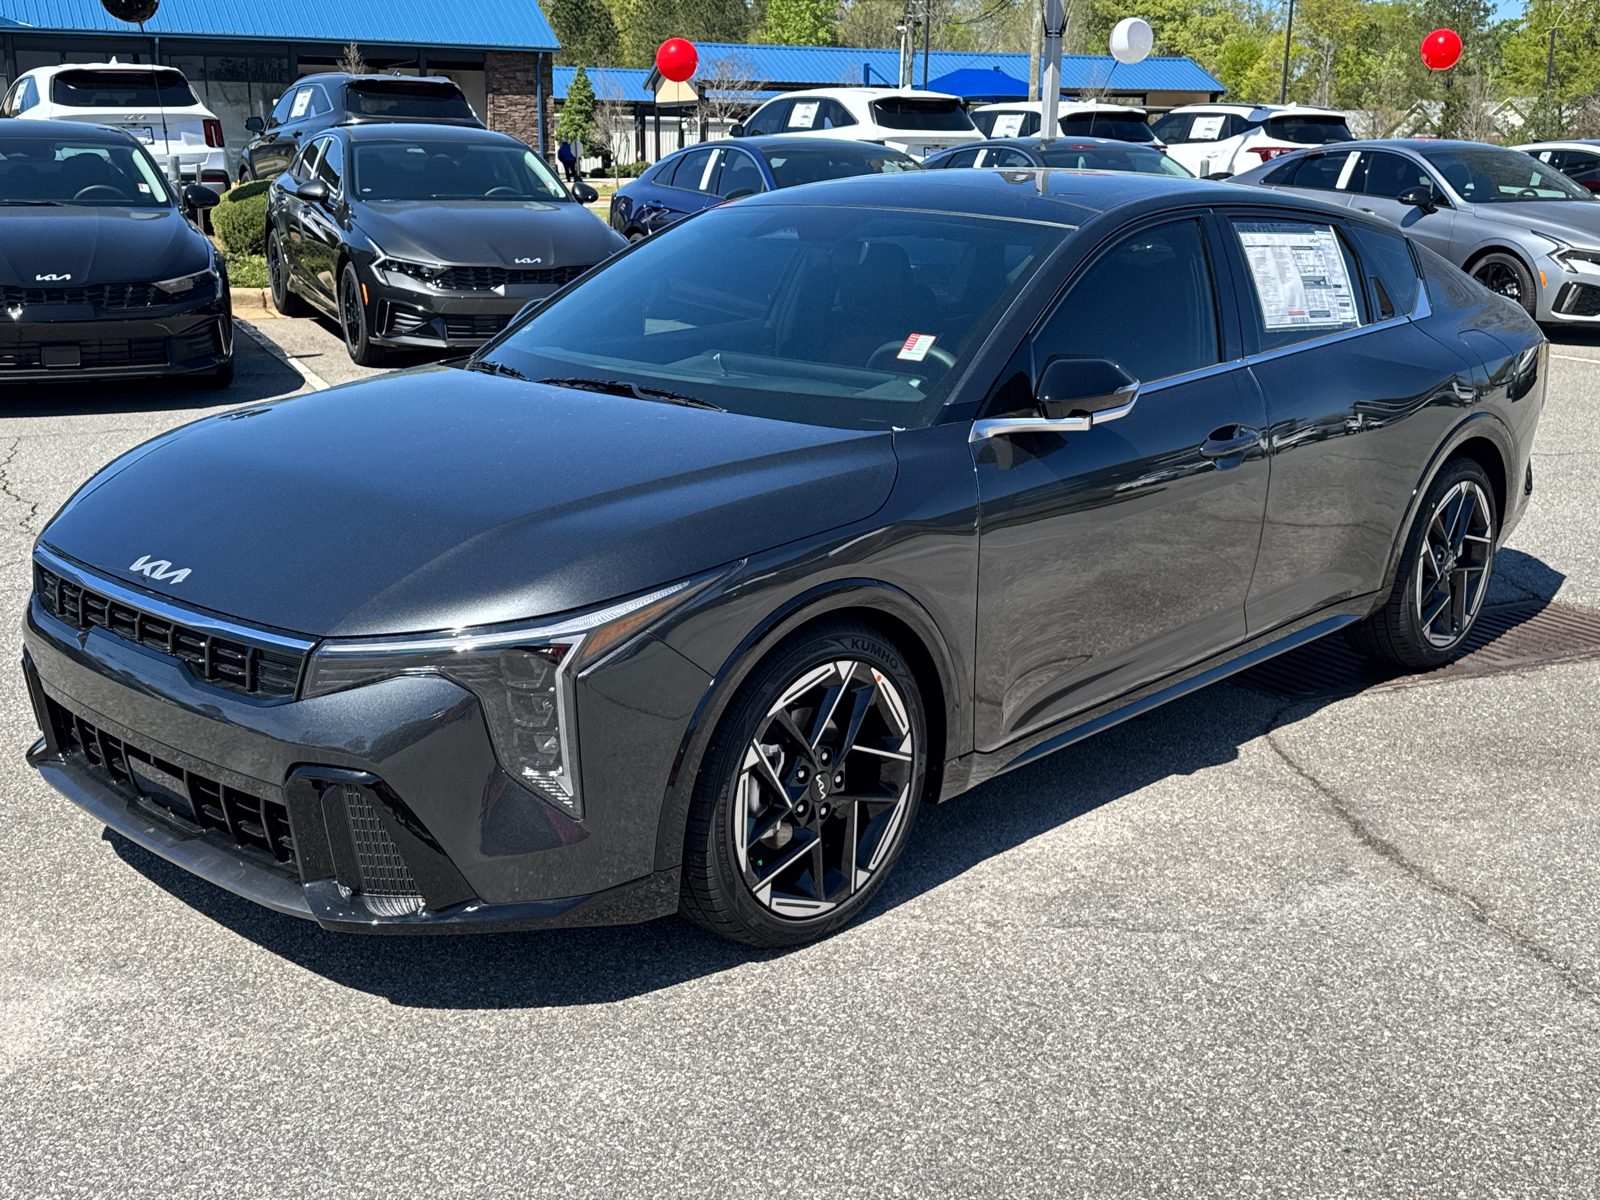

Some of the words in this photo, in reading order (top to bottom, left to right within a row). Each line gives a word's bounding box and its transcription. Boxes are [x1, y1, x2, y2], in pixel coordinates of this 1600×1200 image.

[129, 555, 192, 584] KIA
[851, 638, 898, 669] KUMHO
[720, 784, 728, 813] 91W
[720, 848, 734, 883] 235/40
